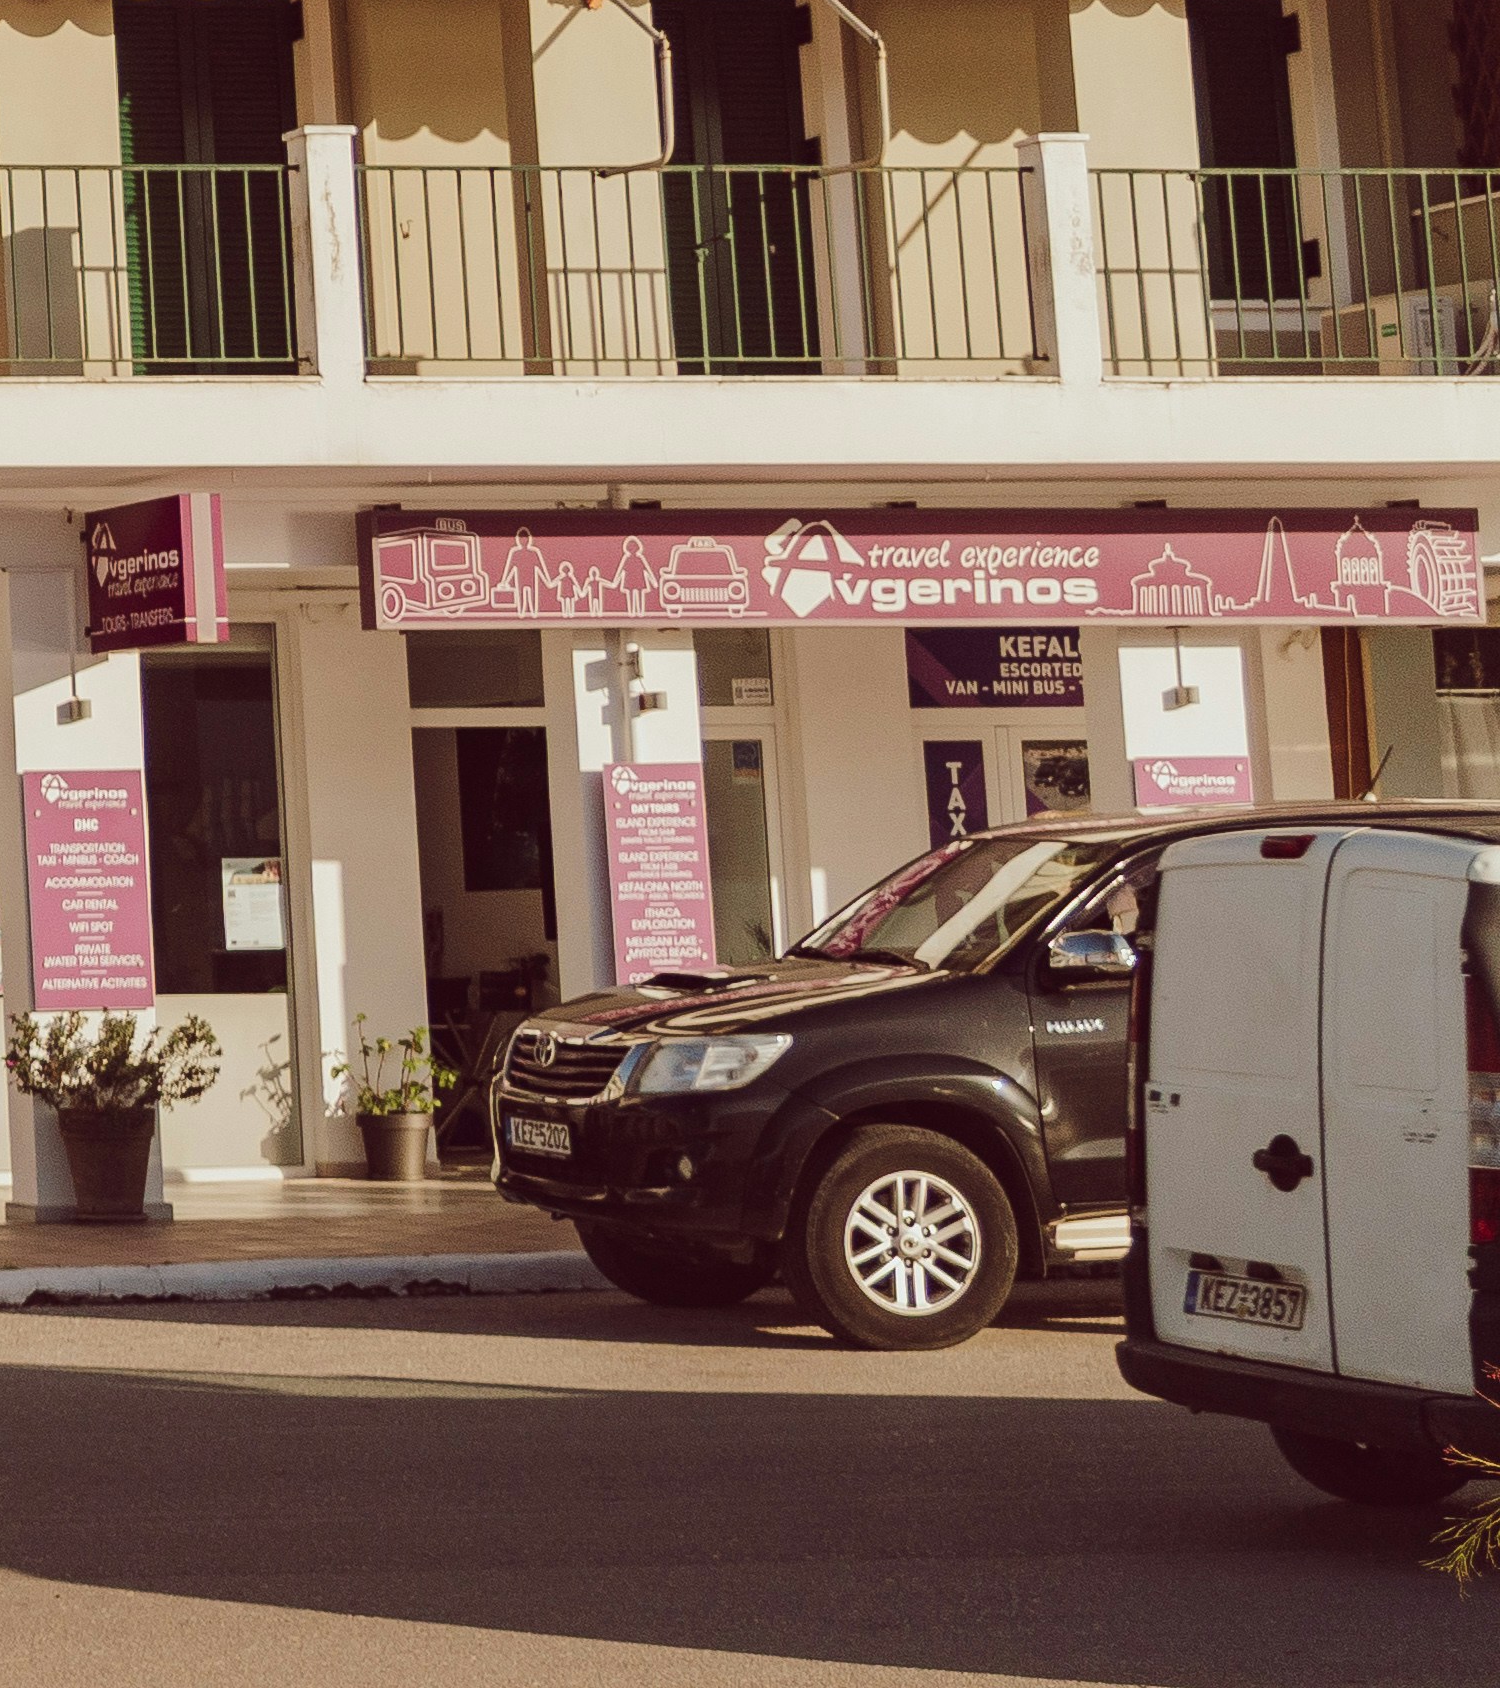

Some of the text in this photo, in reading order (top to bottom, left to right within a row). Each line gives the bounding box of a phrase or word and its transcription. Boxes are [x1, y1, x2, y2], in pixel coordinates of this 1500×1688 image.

[438, 519, 463, 532] BUS
[867, 539, 1101, 576] travel experience
[1000, 636, 1082, 658] KEFAL
[1000, 662, 1083, 679] ESCORTED
[945, 679, 979, 696] VAN
[993, 679, 1030, 696] MINI
[1033, 679, 1066, 696] BUS
[615, 815, 697, 829] ISLAND EXPERIENCE
[49, 842, 126, 854] TRANSPORTATION
[37, 854, 58, 867] TAXI
[102, 853, 140, 866] COACH
[618, 850, 700, 864] ISLAND EXPERIENCE
[44, 875, 135, 889] ACCOMMODATION
[617, 879, 704, 893] KEFALONIA NORTH
[61, 898, 119, 912] CAR RENTAL
[644, 906, 681, 919] ITHACA
[90, 920, 114, 933] SPOT
[631, 918, 696, 931] EXPLORATION
[74, 943, 112, 955] PRIVATE
[668, 946, 702, 959] BEACH
[43, 955, 78, 968] WATER
[78, 955, 99, 967] TAXI
[41, 976, 149, 990] ALTERNATIVE ACTIVITIES
